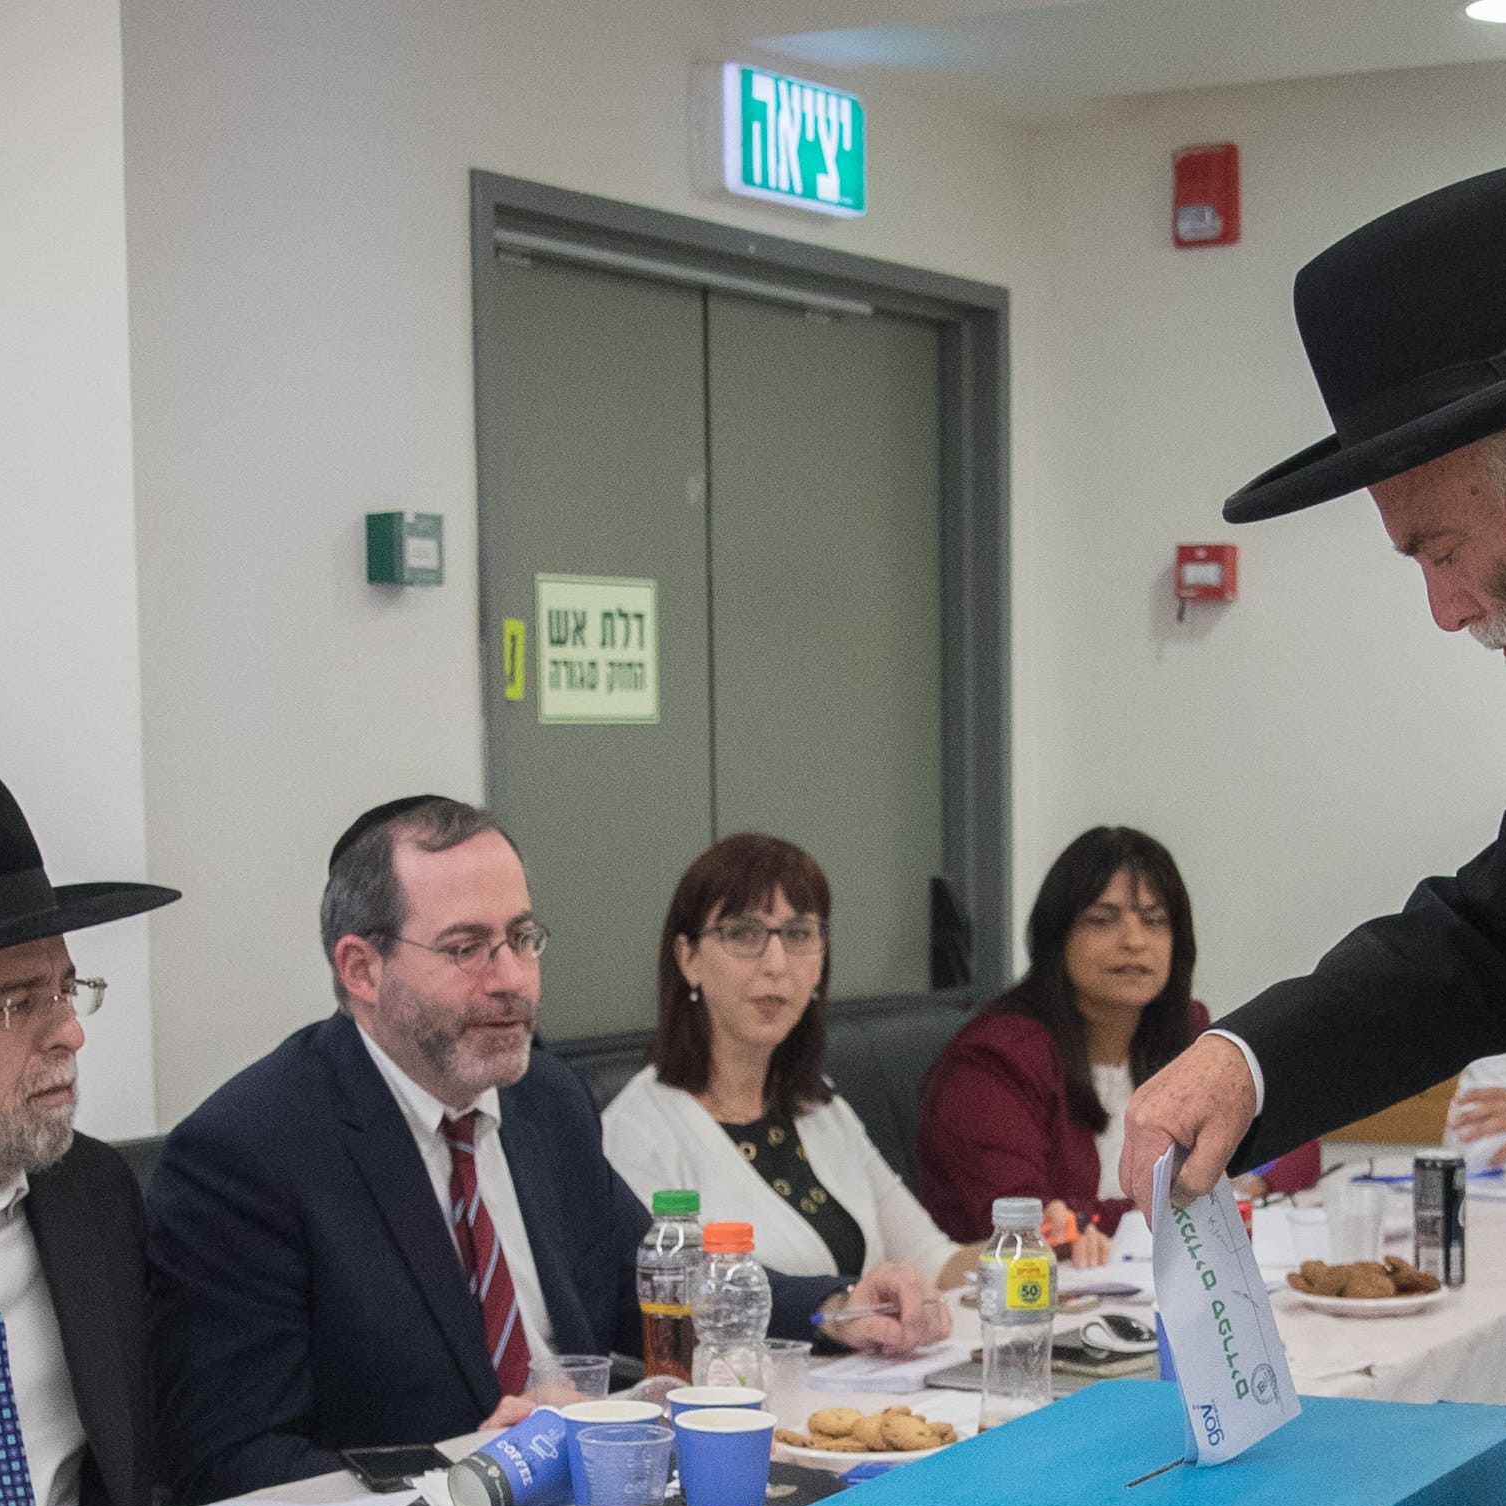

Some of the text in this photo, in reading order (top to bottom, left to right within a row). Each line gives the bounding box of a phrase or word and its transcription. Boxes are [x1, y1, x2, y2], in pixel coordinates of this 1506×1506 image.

[751, 73, 853, 203] יציאה
[548, 607, 647, 651] דלת אש
[1210, 1299, 1251, 1400] ספרדים
[496, 1439, 534, 1486] COFFEE
